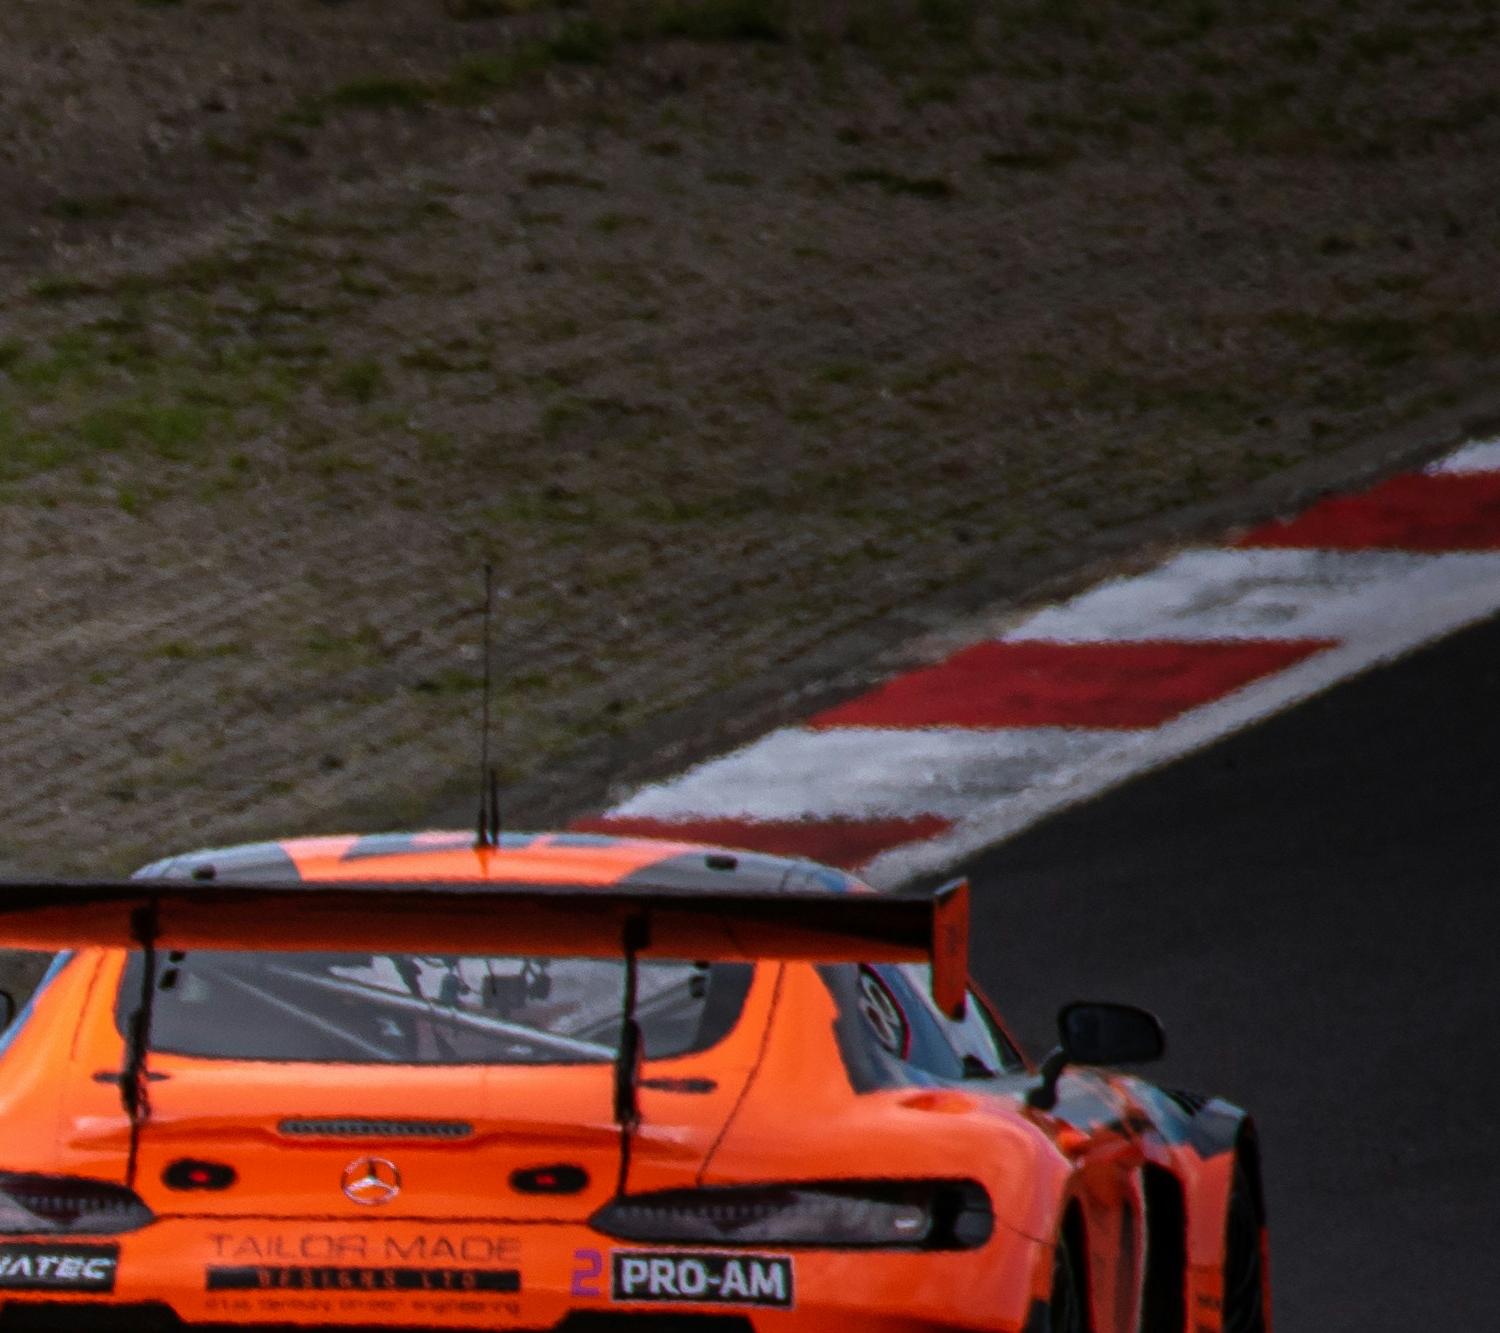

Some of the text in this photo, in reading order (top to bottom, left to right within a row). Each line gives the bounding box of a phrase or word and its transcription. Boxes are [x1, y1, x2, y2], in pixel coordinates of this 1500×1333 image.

[206, 1234, 523, 1262] TAILOR MADE
[570, 1249, 602, 1297] 2
[621, 1257, 787, 1300] PRO-AM
